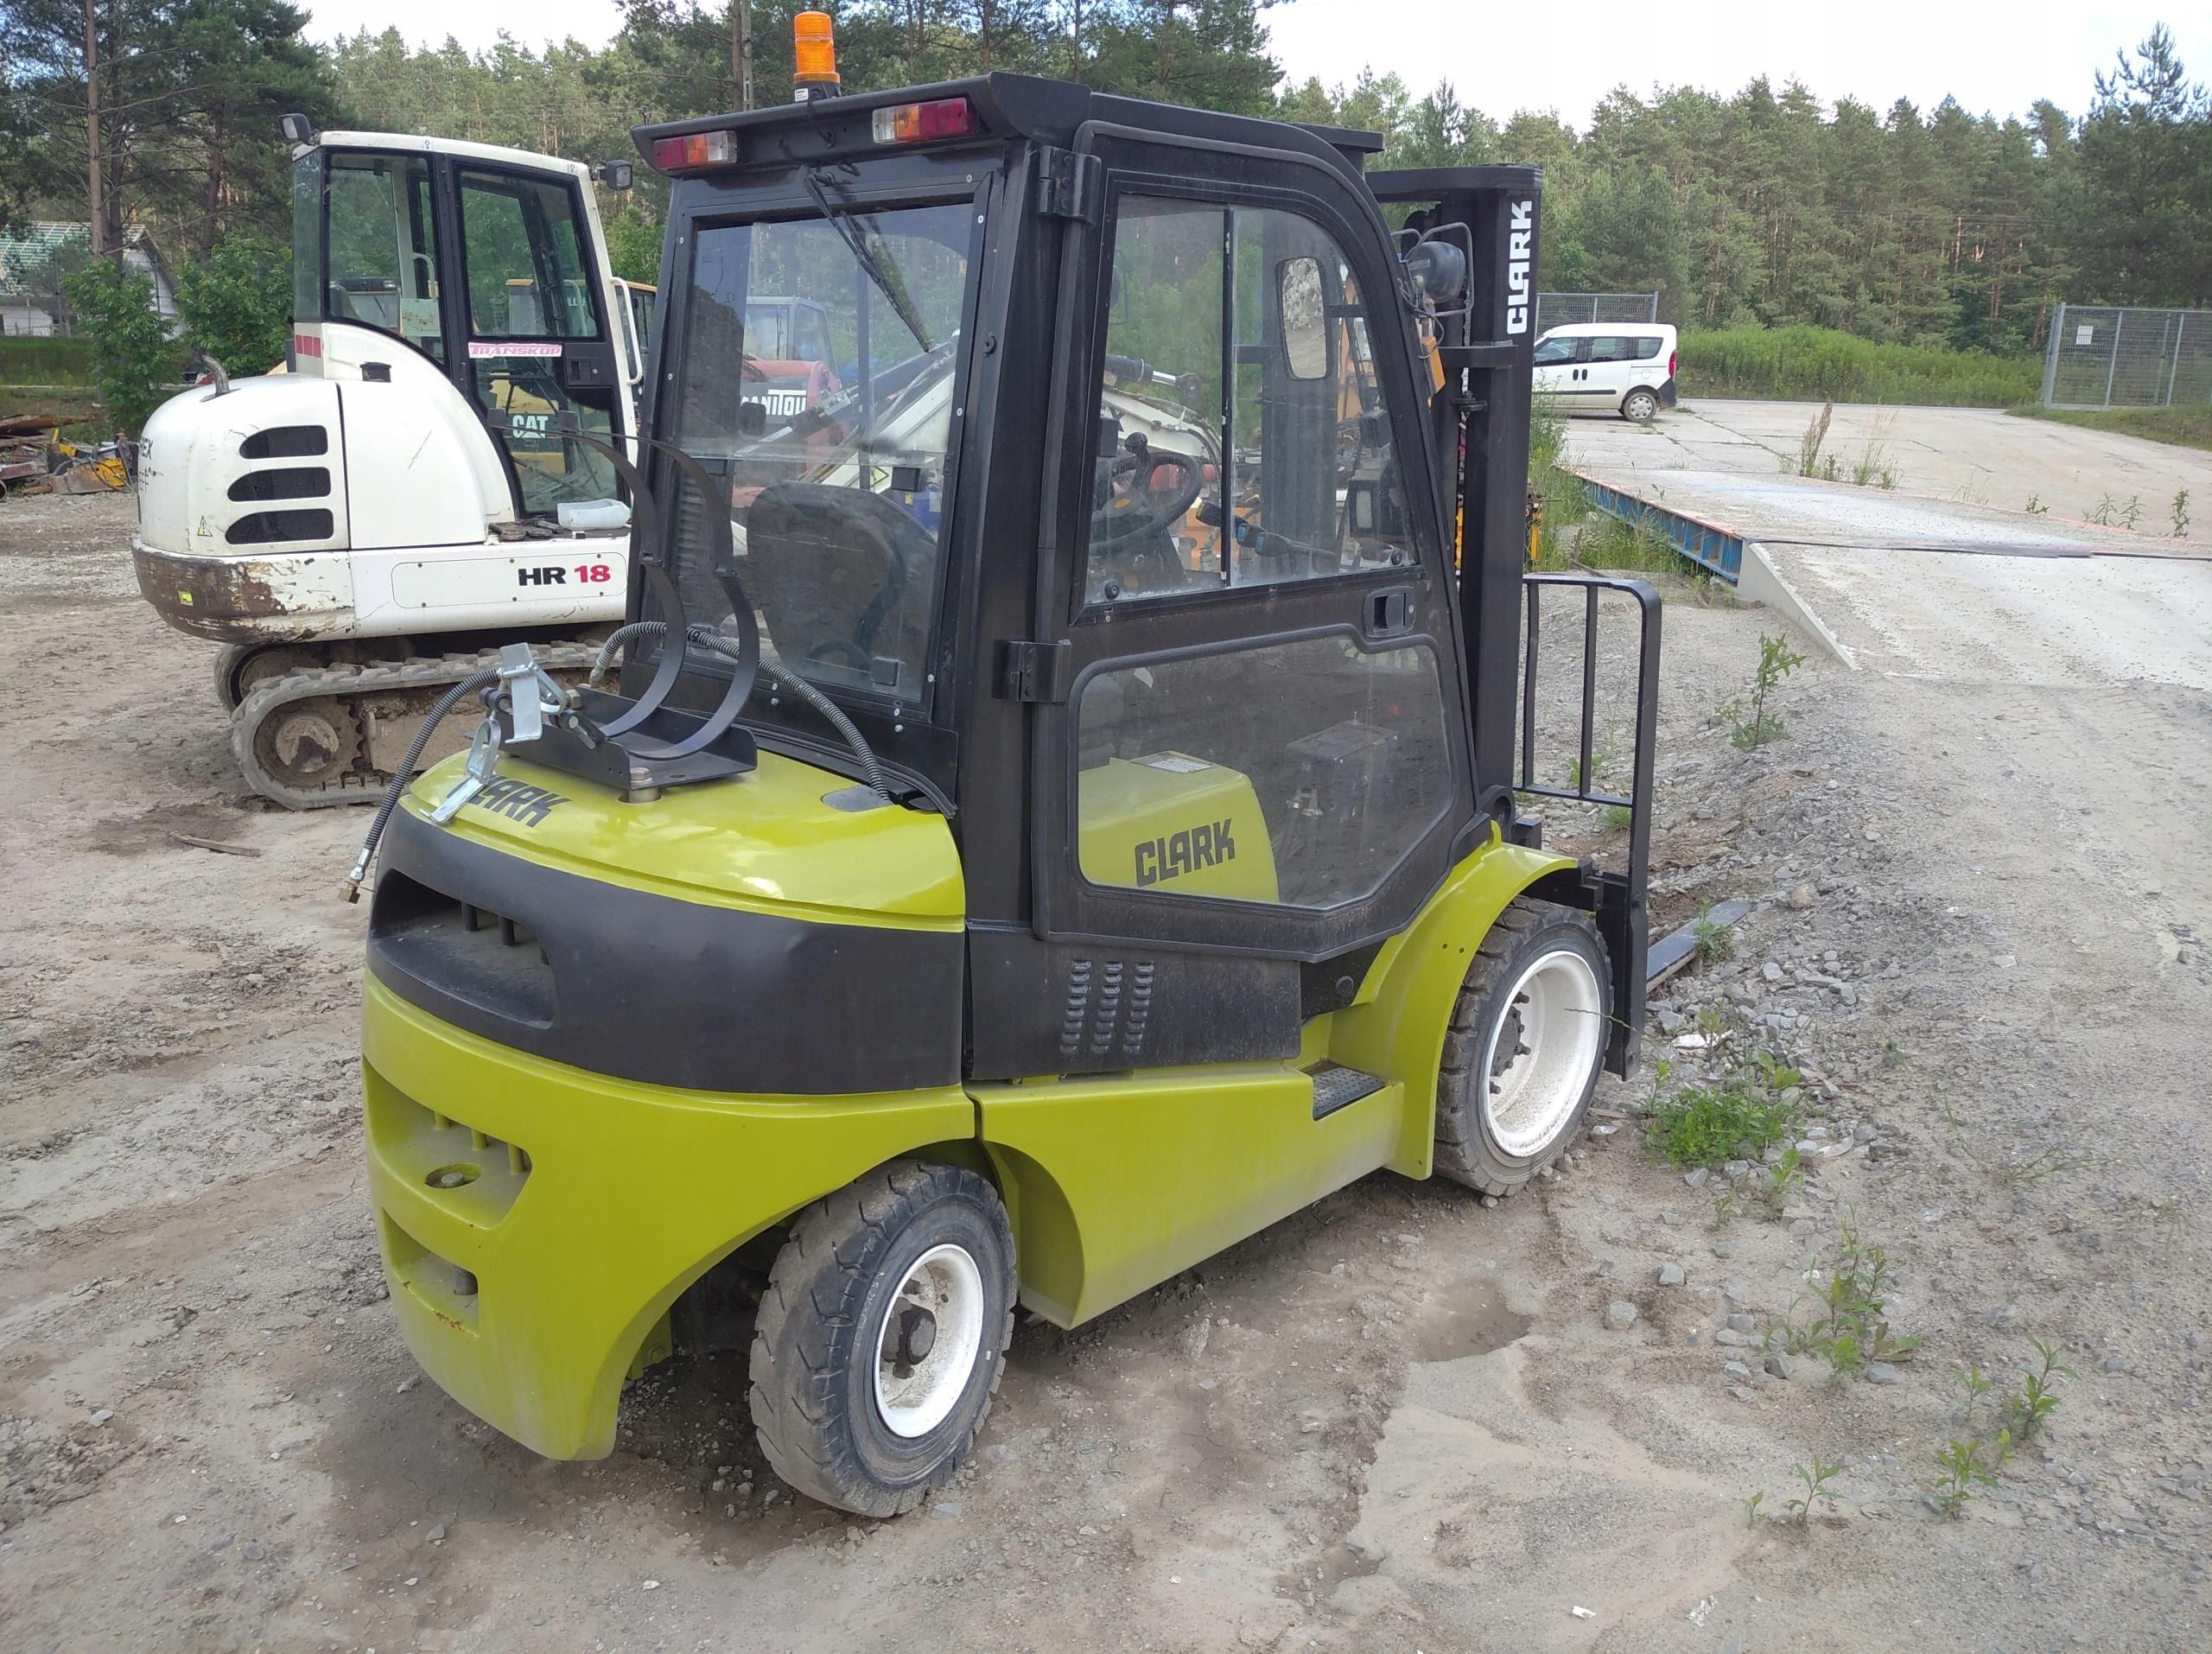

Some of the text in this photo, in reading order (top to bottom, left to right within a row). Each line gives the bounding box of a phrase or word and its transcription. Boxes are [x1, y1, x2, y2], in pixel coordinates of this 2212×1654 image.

[1507, 200, 1532, 334] CLARK
[512, 415, 549, 439] CAT
[518, 564, 611, 586] HR 18
[447, 775, 573, 828] LARK
[1135, 817, 1236, 887] CLARK
